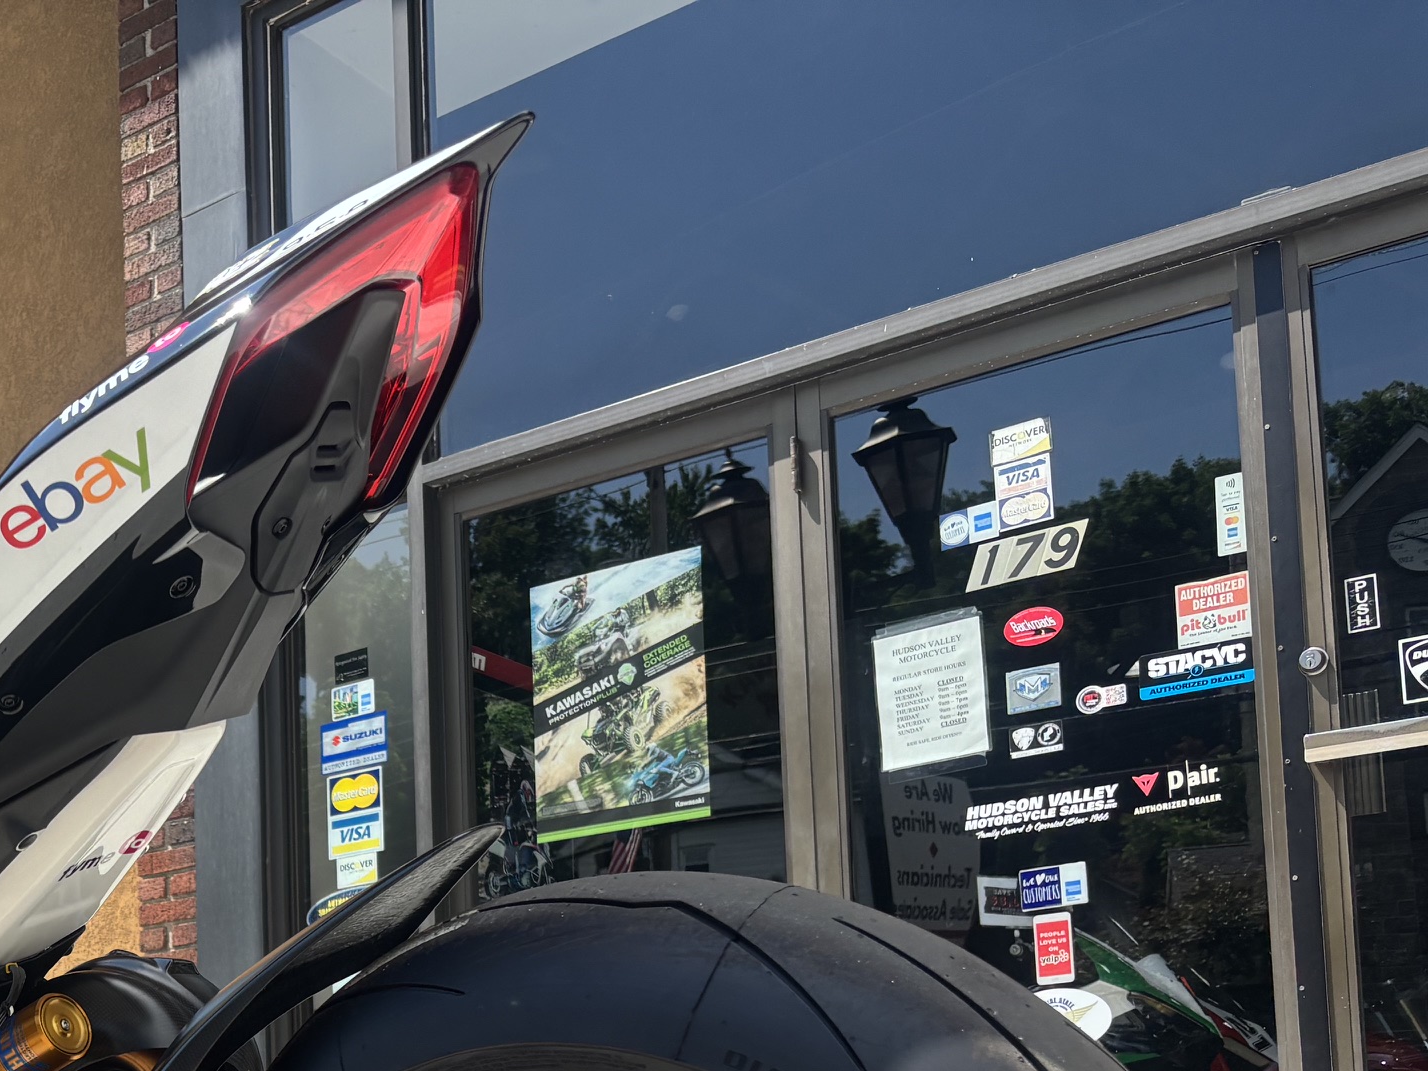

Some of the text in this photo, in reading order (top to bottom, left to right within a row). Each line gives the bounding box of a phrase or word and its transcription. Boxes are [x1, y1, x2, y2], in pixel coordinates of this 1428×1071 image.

[994, 425, 1045, 447] DISCOVER
[1006, 467, 1040, 486] VISA
[0, 427, 151, 549] ebay
[980, 526, 1080, 586] 179
[1180, 577, 1245, 602] AUTHORIZED
[1192, 592, 1234, 611] DEALER
[1354, 580, 1371, 627] PUSH
[1010, 615, 1057, 634] Backroads
[1181, 609, 1246, 636] pit bull
[642, 634, 688, 661] EXTENDED
[643, 640, 692, 669] COVERAGE
[892, 634, 962, 657] HUDSON VALLEY
[899, 645, 957, 664] MOTORCYCLE
[1148, 642, 1247, 680] STACYC
[892, 661, 966, 682] REGULAR STORE HOURS
[894, 676, 964, 695] MONDAY CLOSED
[1149, 672, 1246, 696] AUTHORIZED DEALER
[545, 674, 616, 718] KAWASAKI
[895, 691, 924, 702] TUESDAY
[895, 695, 935, 708] WEDNESDAY
[896, 704, 929, 716] THURSDAY
[896, 713, 920, 723] FRIDAY
[897, 718, 931, 730] SATURDAY
[898, 717, 967, 736] SUNDAY CLOSED
[342, 727, 383, 743] SUZUKI
[332, 785, 378, 803] MasterCard
[675, 796, 705, 808] Kawasaki
[966, 783, 1119, 820] HUDSON VALLEY
[1134, 794, 1222, 816] AUTHORIZED DEALER
[965, 808, 1056, 831] MOTORCYCLE
[1059, 799, 1105, 817] SALES
[339, 826, 371, 844] VISA
[975, 828, 1000, 840] Family
[1089, 812, 1109, 823] 1966
[340, 860, 373, 871] DISCOVER
[1023, 884, 1061, 904] CUSTOMERS
[1040, 930, 1066, 938] PEOPLE
[1041, 955, 1060, 966] yelp
